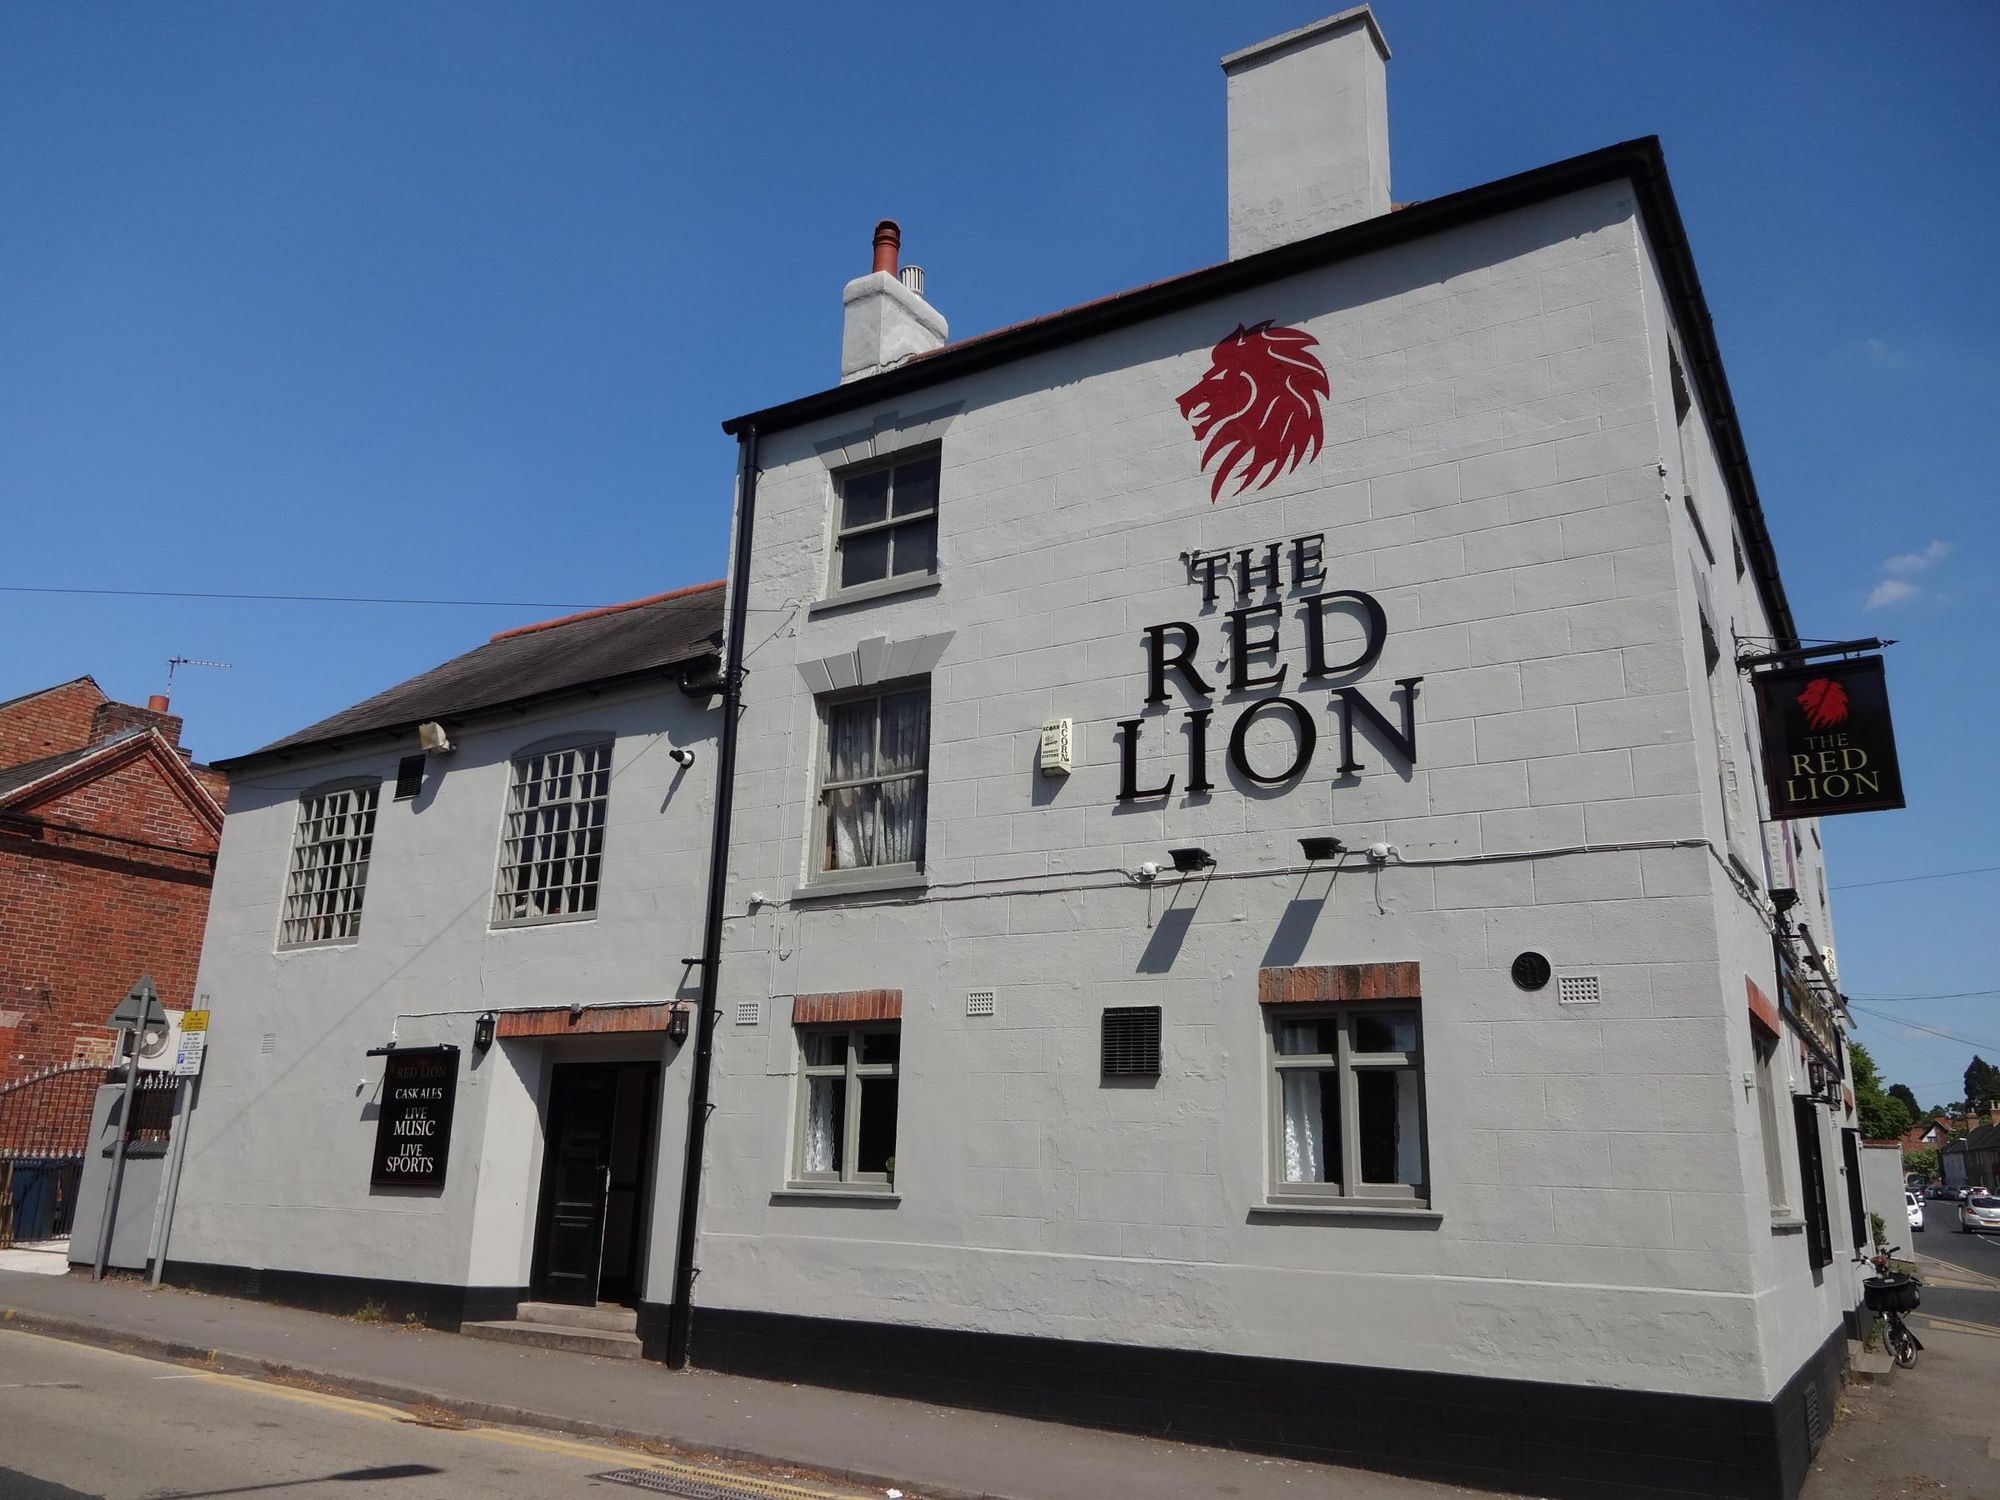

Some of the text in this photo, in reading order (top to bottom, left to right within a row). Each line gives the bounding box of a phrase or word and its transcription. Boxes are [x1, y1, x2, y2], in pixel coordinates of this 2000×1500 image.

[1191, 533, 1327, 601] THE
[1143, 589, 1387, 703] RED
[1060, 721, 1069, 761] ACORN
[1116, 676, 1424, 800] LION
[1804, 732, 1848, 749] THE
[1791, 748, 1867, 776] RED
[1786, 771, 1880, 802] LION
[397, 1064, 447, 1079] RED LION
[395, 1087, 443, 1100] CASK ALES
[405, 1106, 428, 1120] LIVE
[393, 1120, 436, 1136] MUSIC
[400, 1143, 423, 1157] LIVE
[386, 1156, 434, 1173] SPORTS
